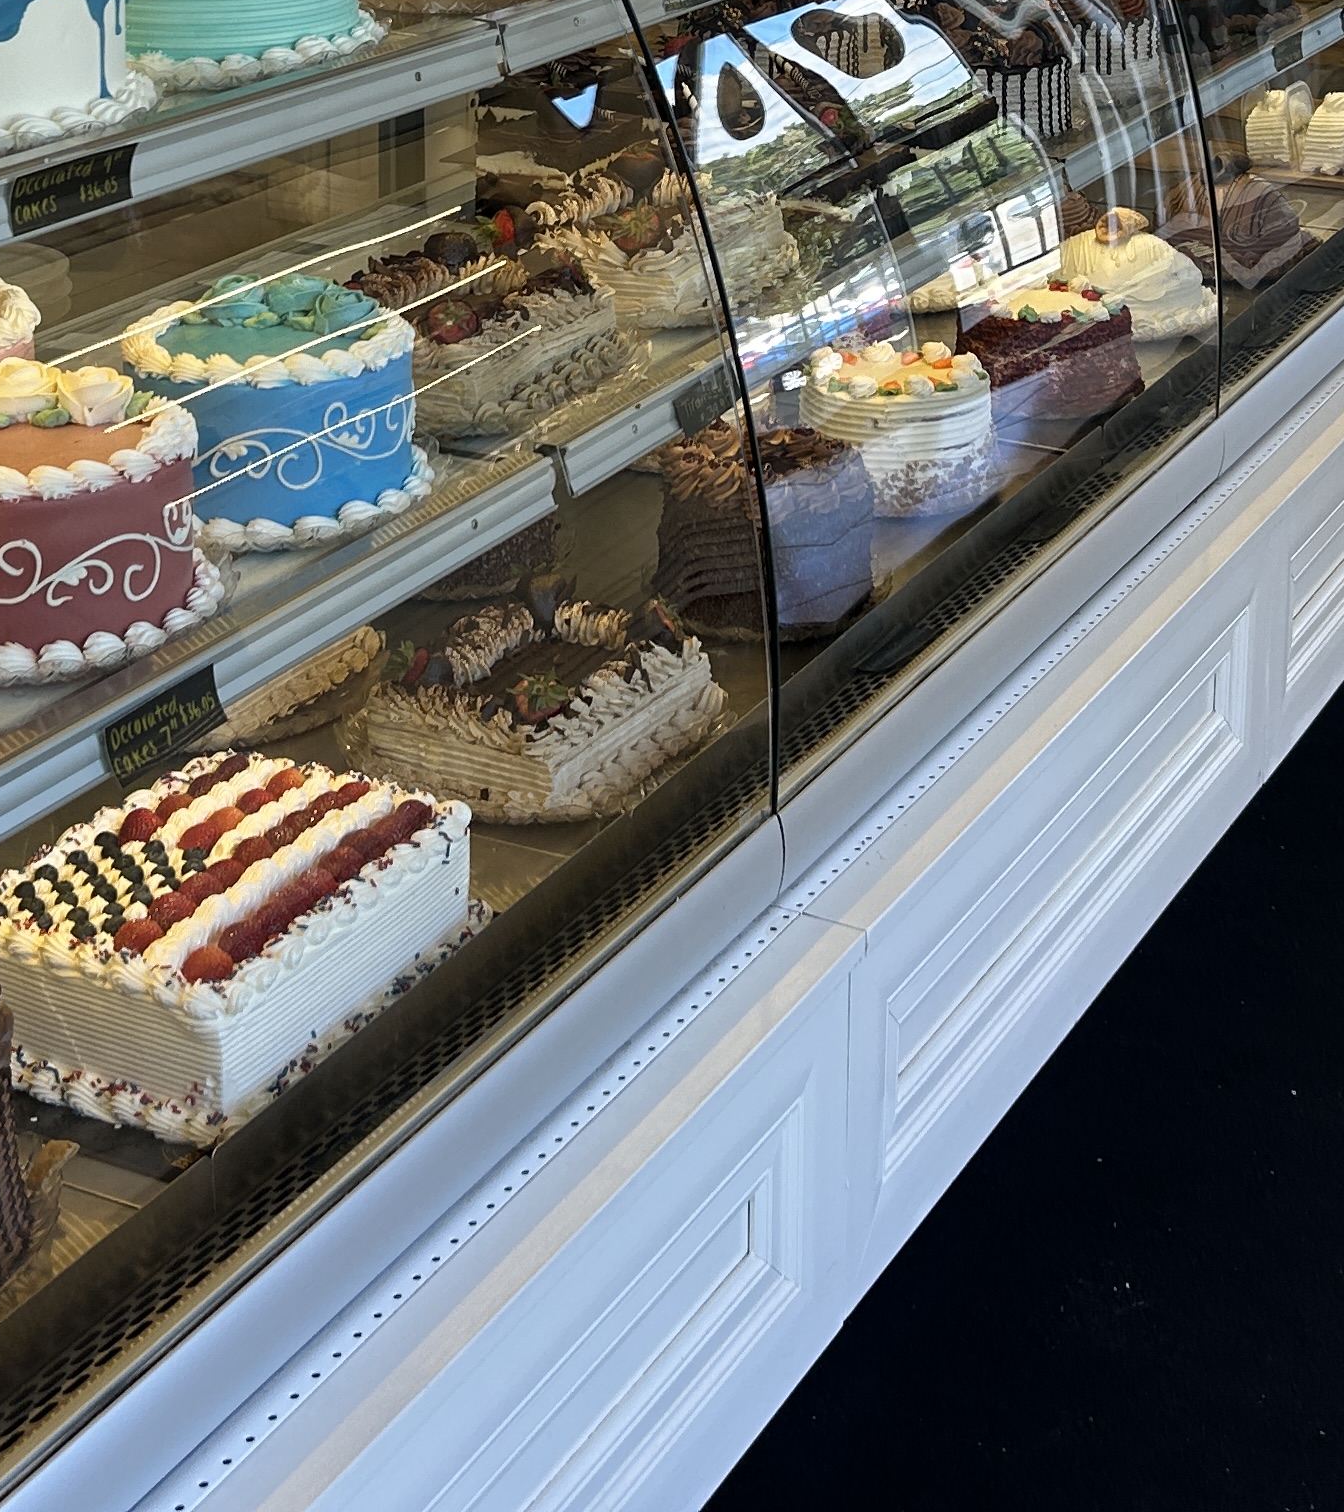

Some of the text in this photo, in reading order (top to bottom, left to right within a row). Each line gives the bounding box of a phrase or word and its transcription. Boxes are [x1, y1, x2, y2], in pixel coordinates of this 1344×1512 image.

[15, 158, 95, 199] Decorated
[110, 695, 178, 751] Decorated
[159, 717, 179, 746] 7"
